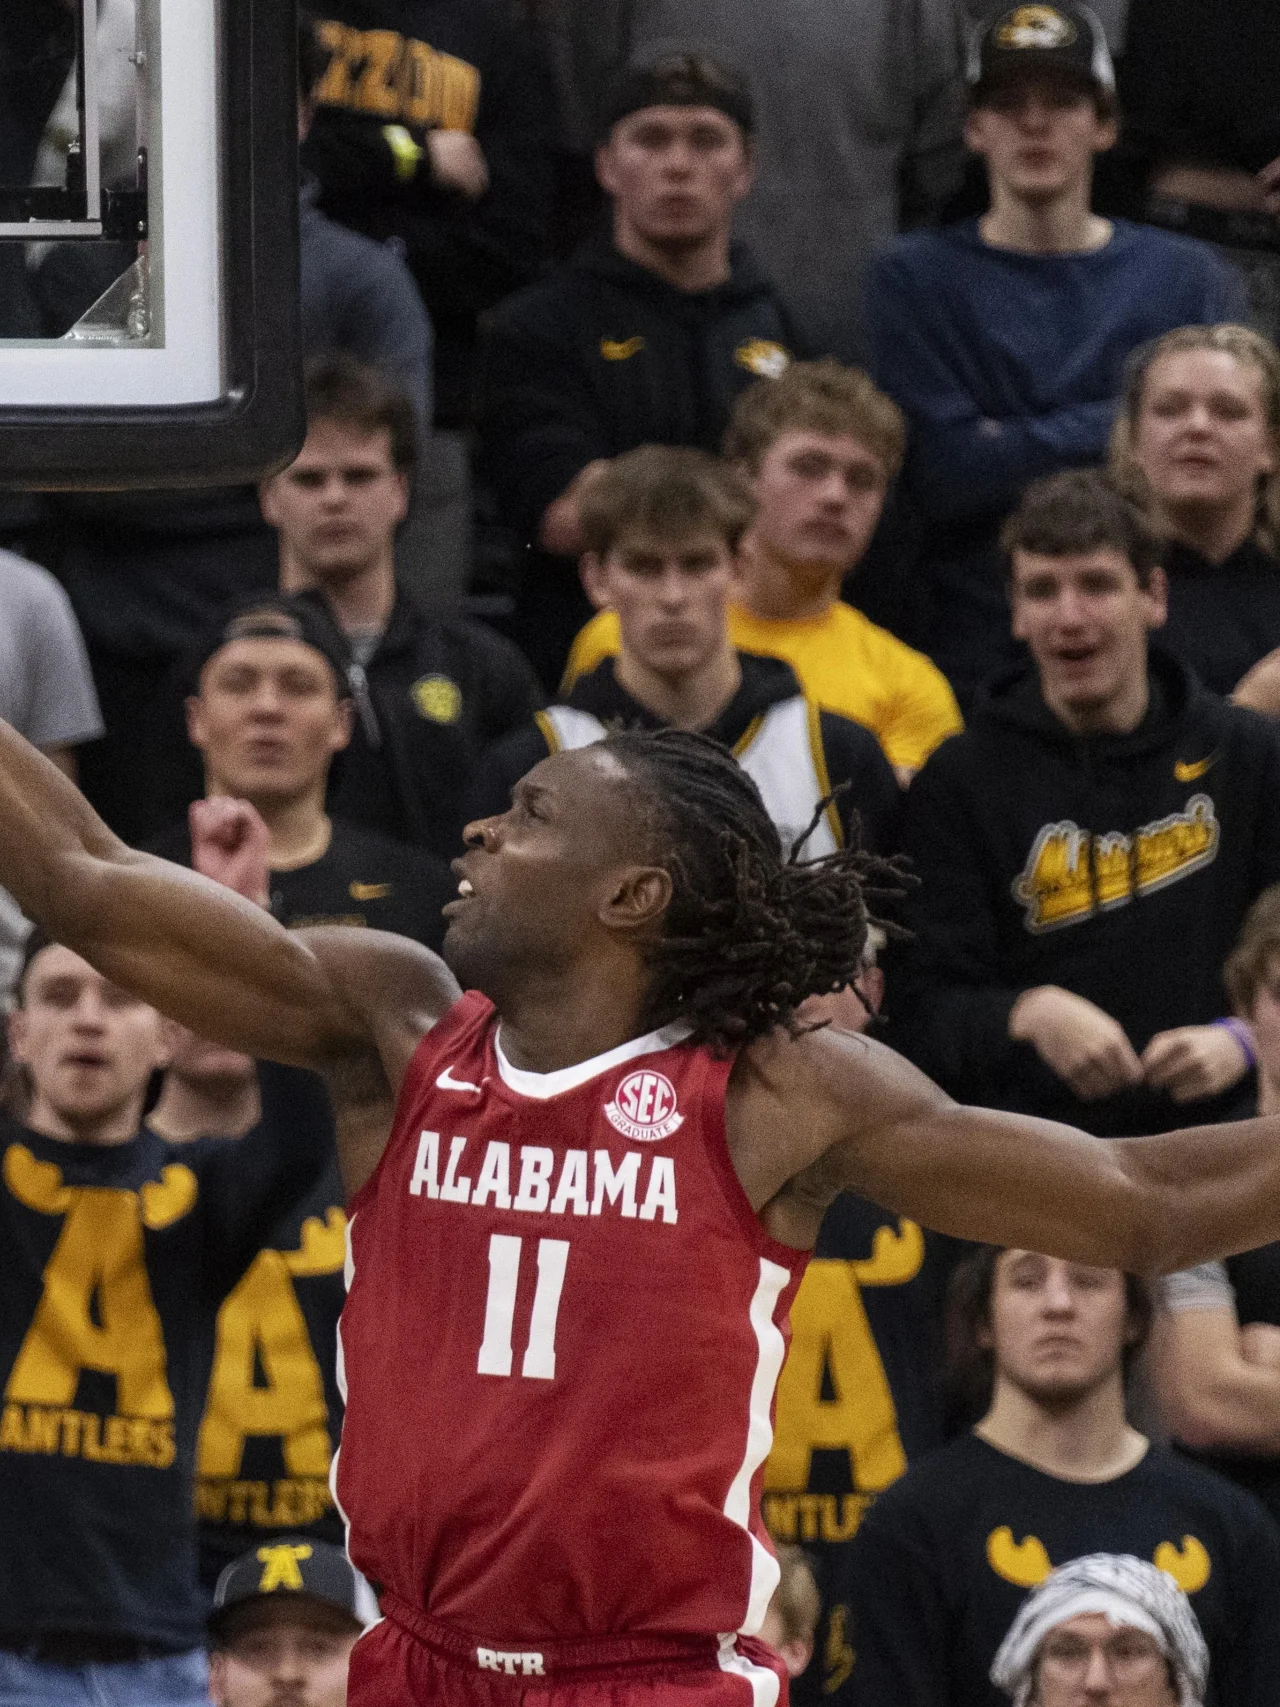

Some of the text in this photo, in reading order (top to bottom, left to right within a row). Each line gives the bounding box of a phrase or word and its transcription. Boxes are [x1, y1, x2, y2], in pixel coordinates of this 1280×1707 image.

[621, 1074, 672, 1123] SEC
[609, 1113, 672, 1139] GRADUATE
[409, 1130, 679, 1225] ALABAMA
[477, 1233, 571, 1380] 11
[477, 1646, 547, 1676] RTR
